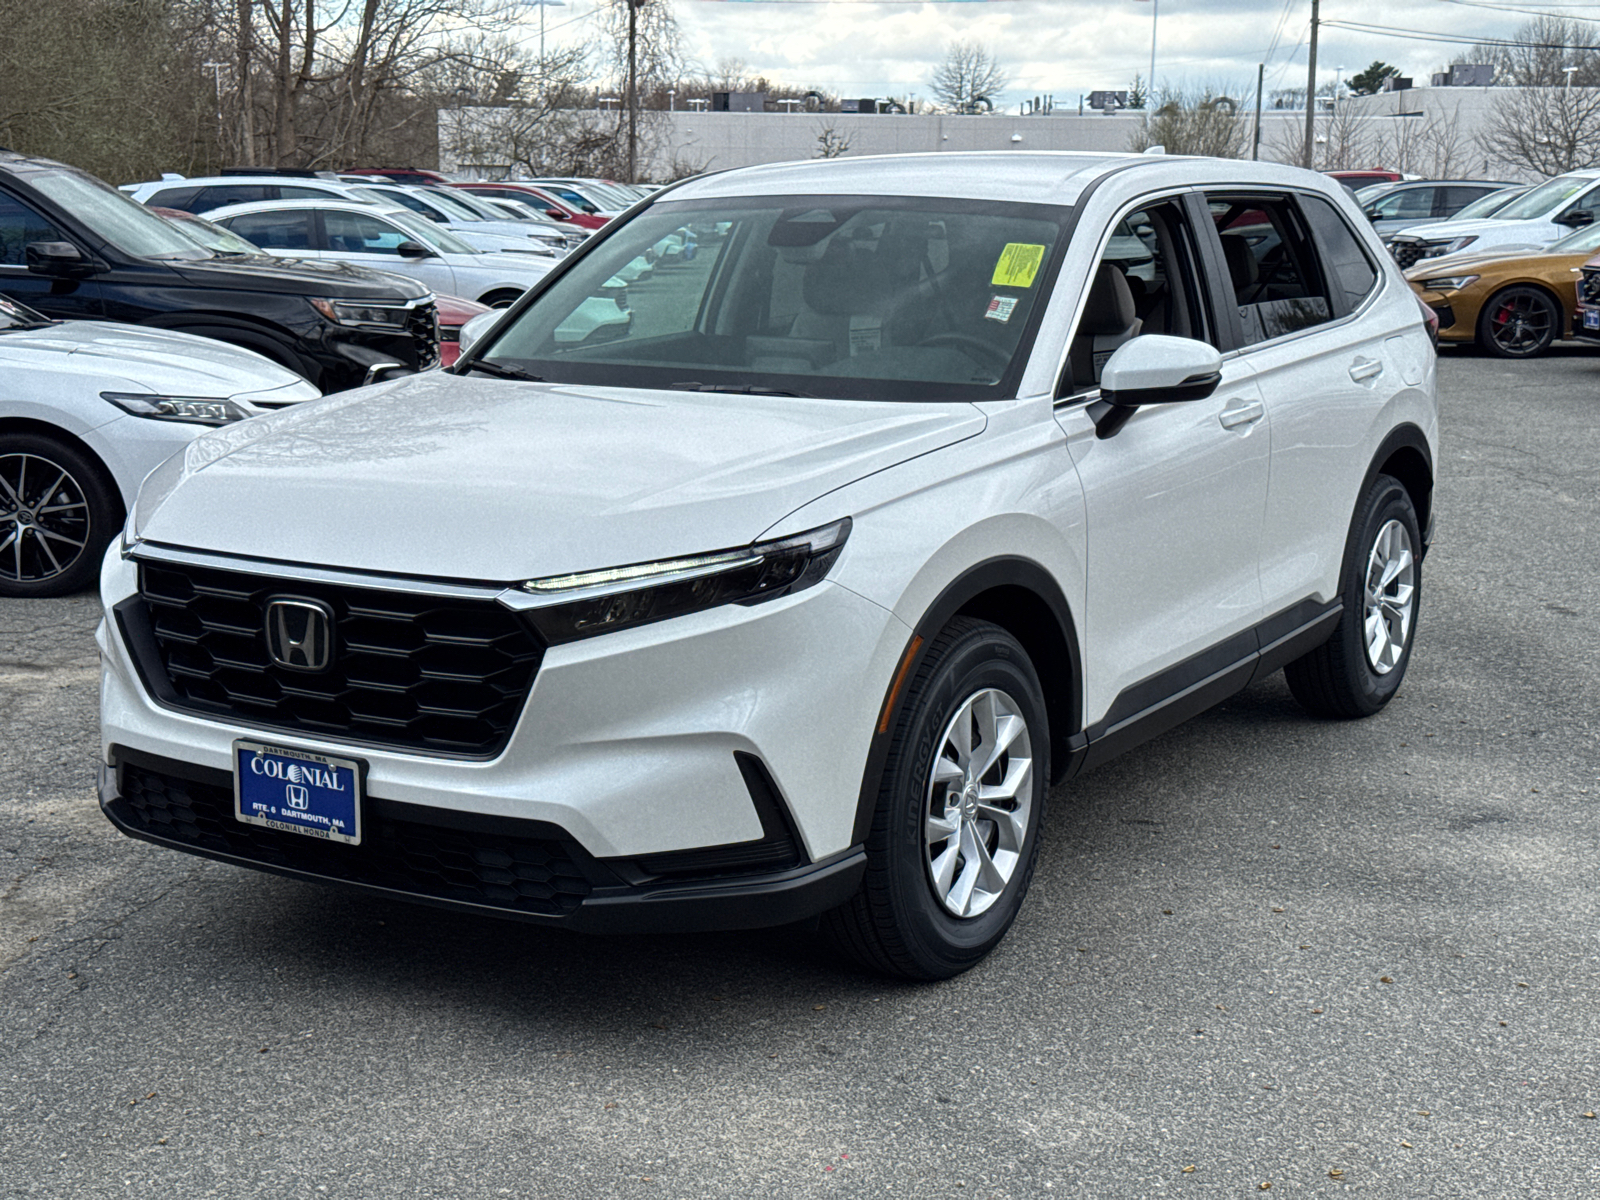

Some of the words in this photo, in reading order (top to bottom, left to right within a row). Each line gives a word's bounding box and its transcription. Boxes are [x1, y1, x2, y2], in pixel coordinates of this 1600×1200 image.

[251, 756, 345, 791] COLONIAL
[906, 724, 932, 846] KINERGY
[931, 701, 944, 731] GT
[252, 802, 270, 812] RTE.
[270, 806, 276, 814] 6
[281, 808, 332, 827] DARTMOUTH,
[332, 818, 345, 828] MA
[265, 820, 302, 833] COLONIAL
[303, 827, 331, 839] HONDA
